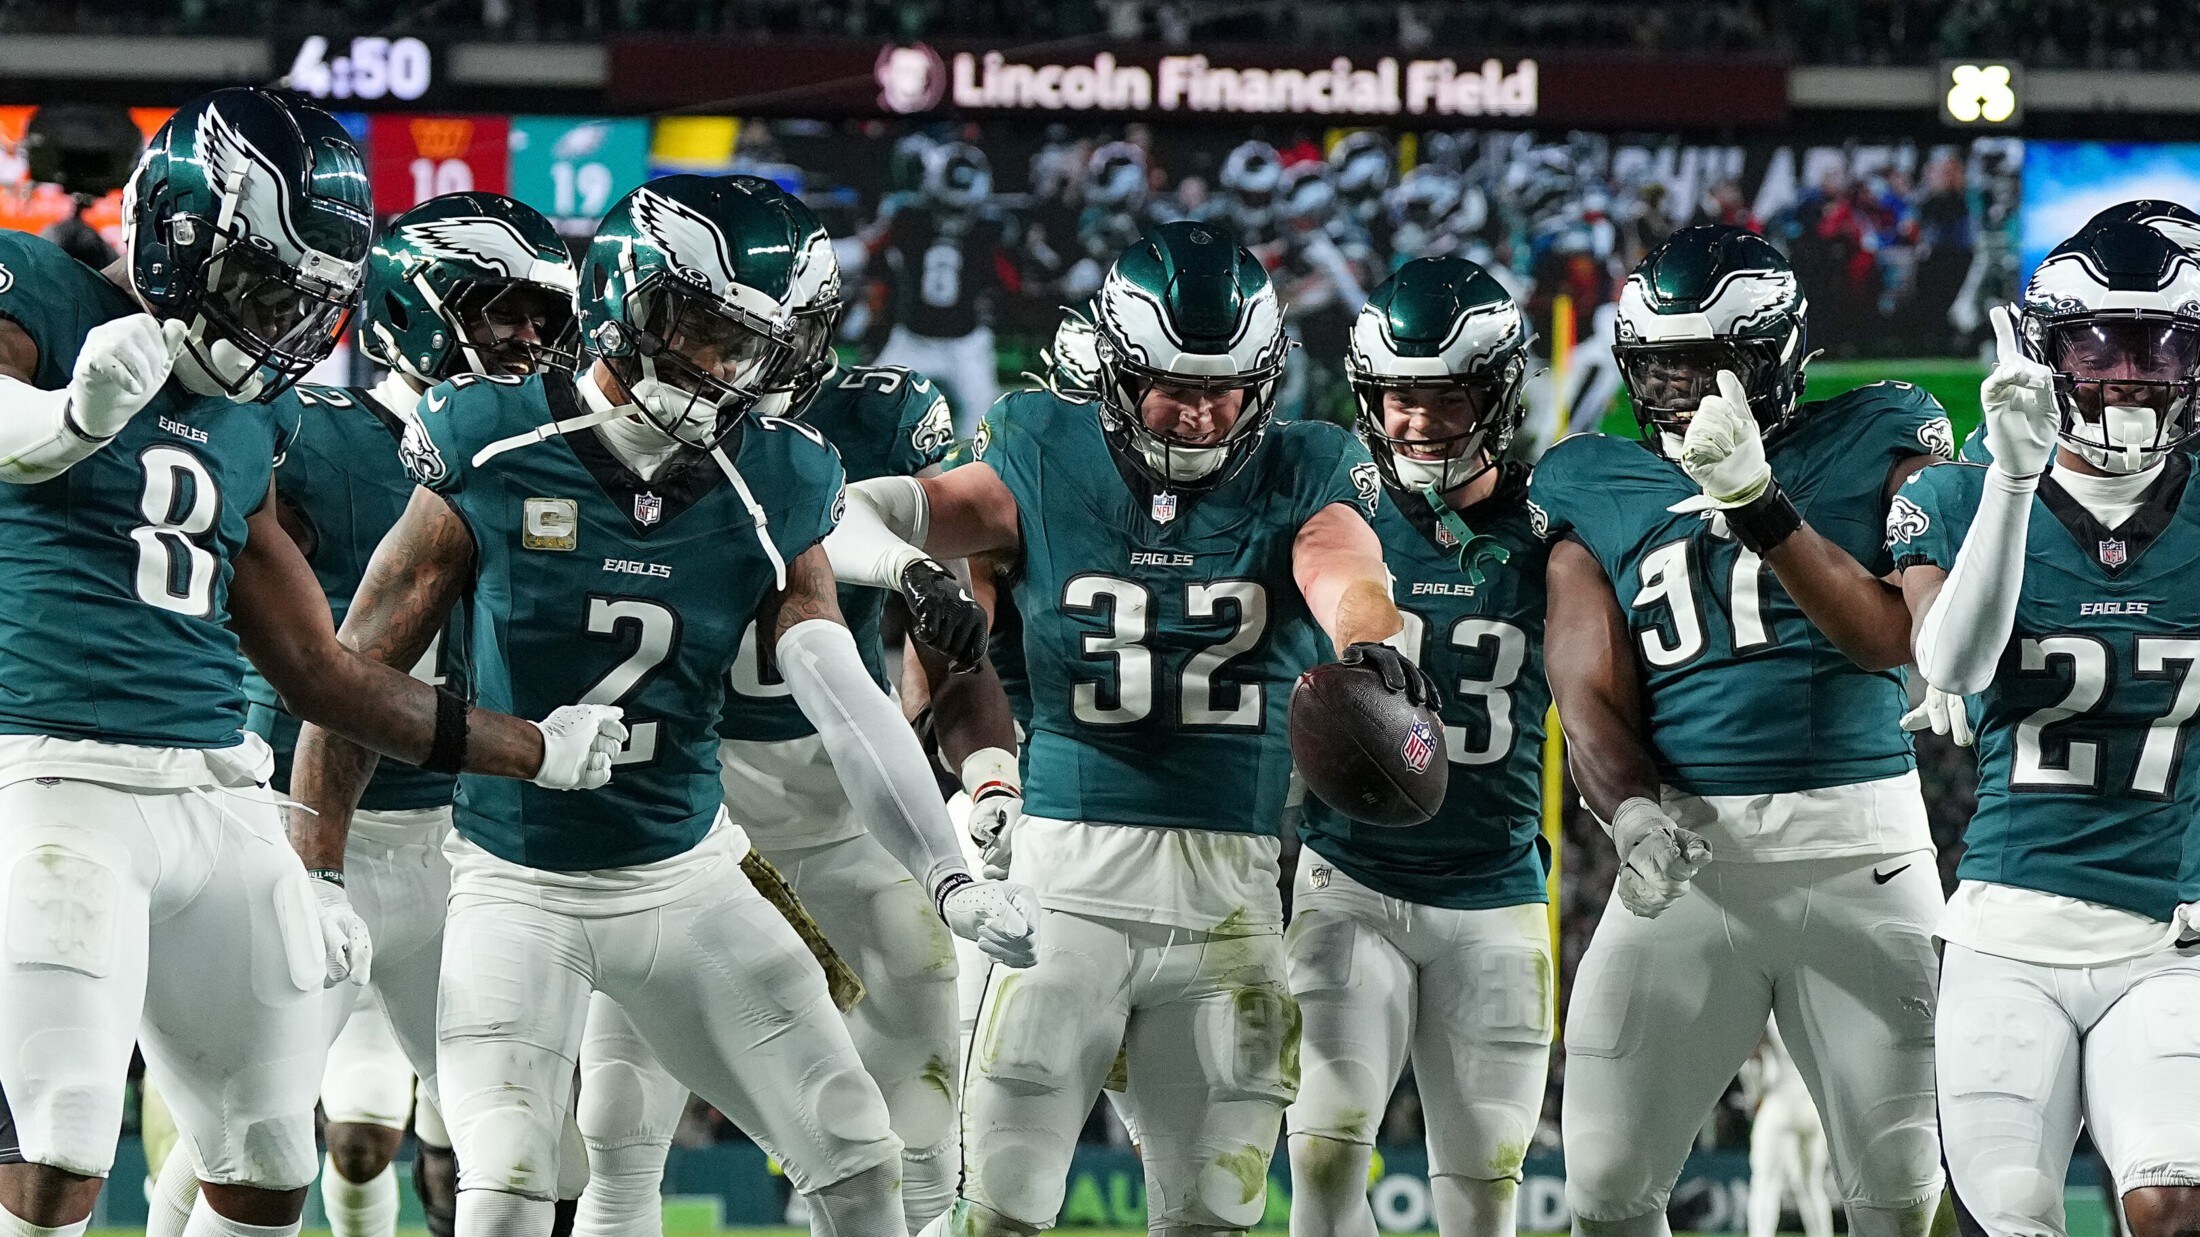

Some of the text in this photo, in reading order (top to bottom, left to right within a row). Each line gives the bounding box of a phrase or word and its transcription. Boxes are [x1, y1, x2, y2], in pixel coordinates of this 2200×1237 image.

[291, 35, 431, 99] 4:50
[952, 51, 1539, 116] Lincoln Financial Field
[410, 157, 474, 202] 10
[552, 159, 612, 217] 19
[838, 364, 909, 394] 5
[158, 415, 209, 444] EAGLES
[130, 444, 221, 620] 8
[527, 501, 577, 538] C
[602, 558, 672, 579] EAGLES
[1130, 552, 1195, 567] EAGLES
[1411, 582, 1477, 597] EAGLES
[1630, 510, 1770, 666] 97
[2080, 602, 2150, 616] EAGLES
[1062, 573, 1270, 731] 32
[575, 598, 674, 766] 2
[2012, 637, 2200, 795] 27
[1405, 734, 1432, 770] NFL
